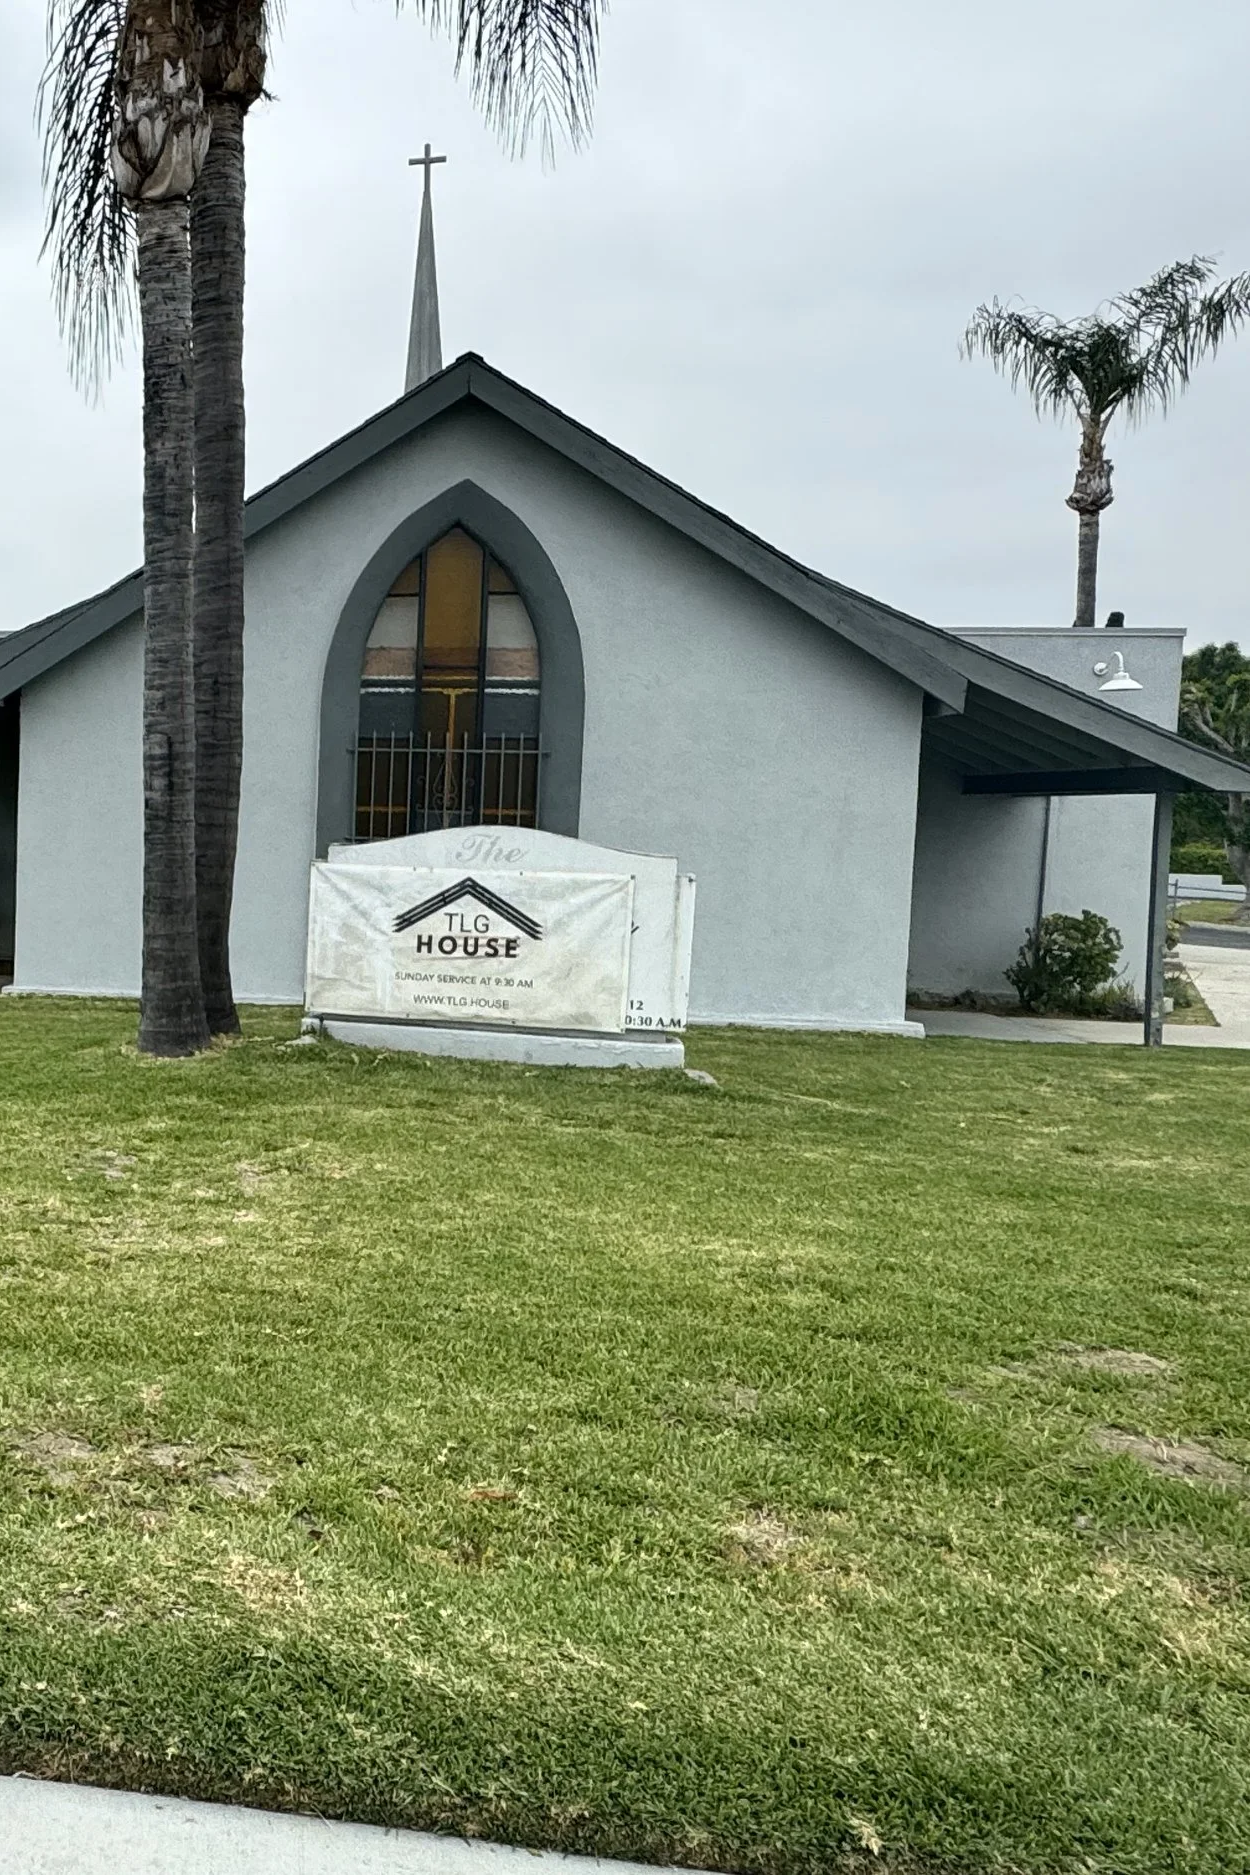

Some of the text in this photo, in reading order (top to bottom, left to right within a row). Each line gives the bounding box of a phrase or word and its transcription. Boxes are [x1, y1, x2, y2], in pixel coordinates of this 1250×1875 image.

[455, 833, 524, 864] The
[444, 913, 490, 933] TLG
[415, 934, 519, 958] HOUSE
[395, 971, 533, 988] SUNDAY SERVICE AT 9:30 AM
